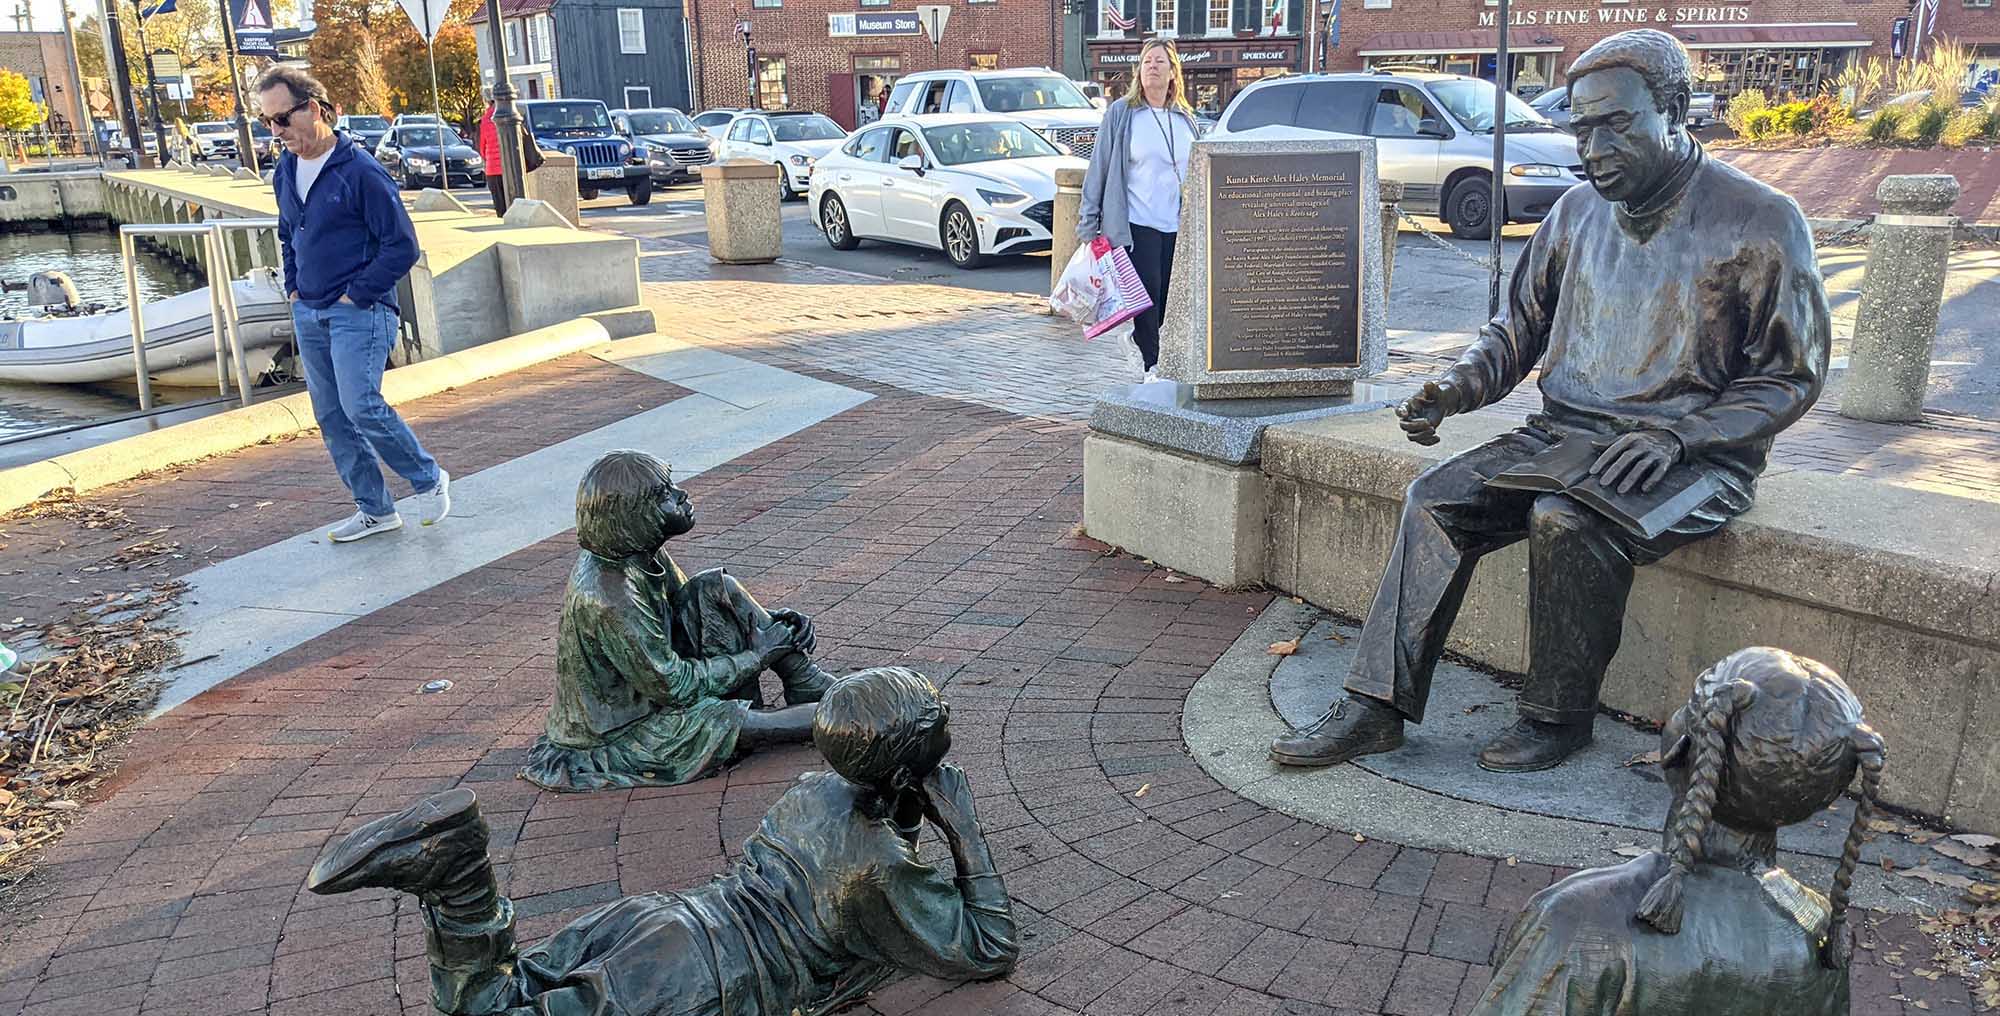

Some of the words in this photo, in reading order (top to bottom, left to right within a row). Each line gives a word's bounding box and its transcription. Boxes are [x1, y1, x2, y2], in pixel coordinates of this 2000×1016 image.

[1478, 11, 1536, 26] MLLS
[1544, 10, 1589, 24] FINE
[1598, 8, 1648, 23] WINE
[1656, 9, 1668, 22] &
[1675, 8, 1748, 22] SPIRITS
[859, 20, 892, 30] Museum
[895, 19, 916, 29] Store
[1226, 176, 1248, 184] Kunta
[1250, 174, 1287, 183] Kinte-Alex
[1289, 174, 1308, 183] Haley
[1312, 173, 1345, 181] Memorial
[1316, 188, 1337, 198] healing
